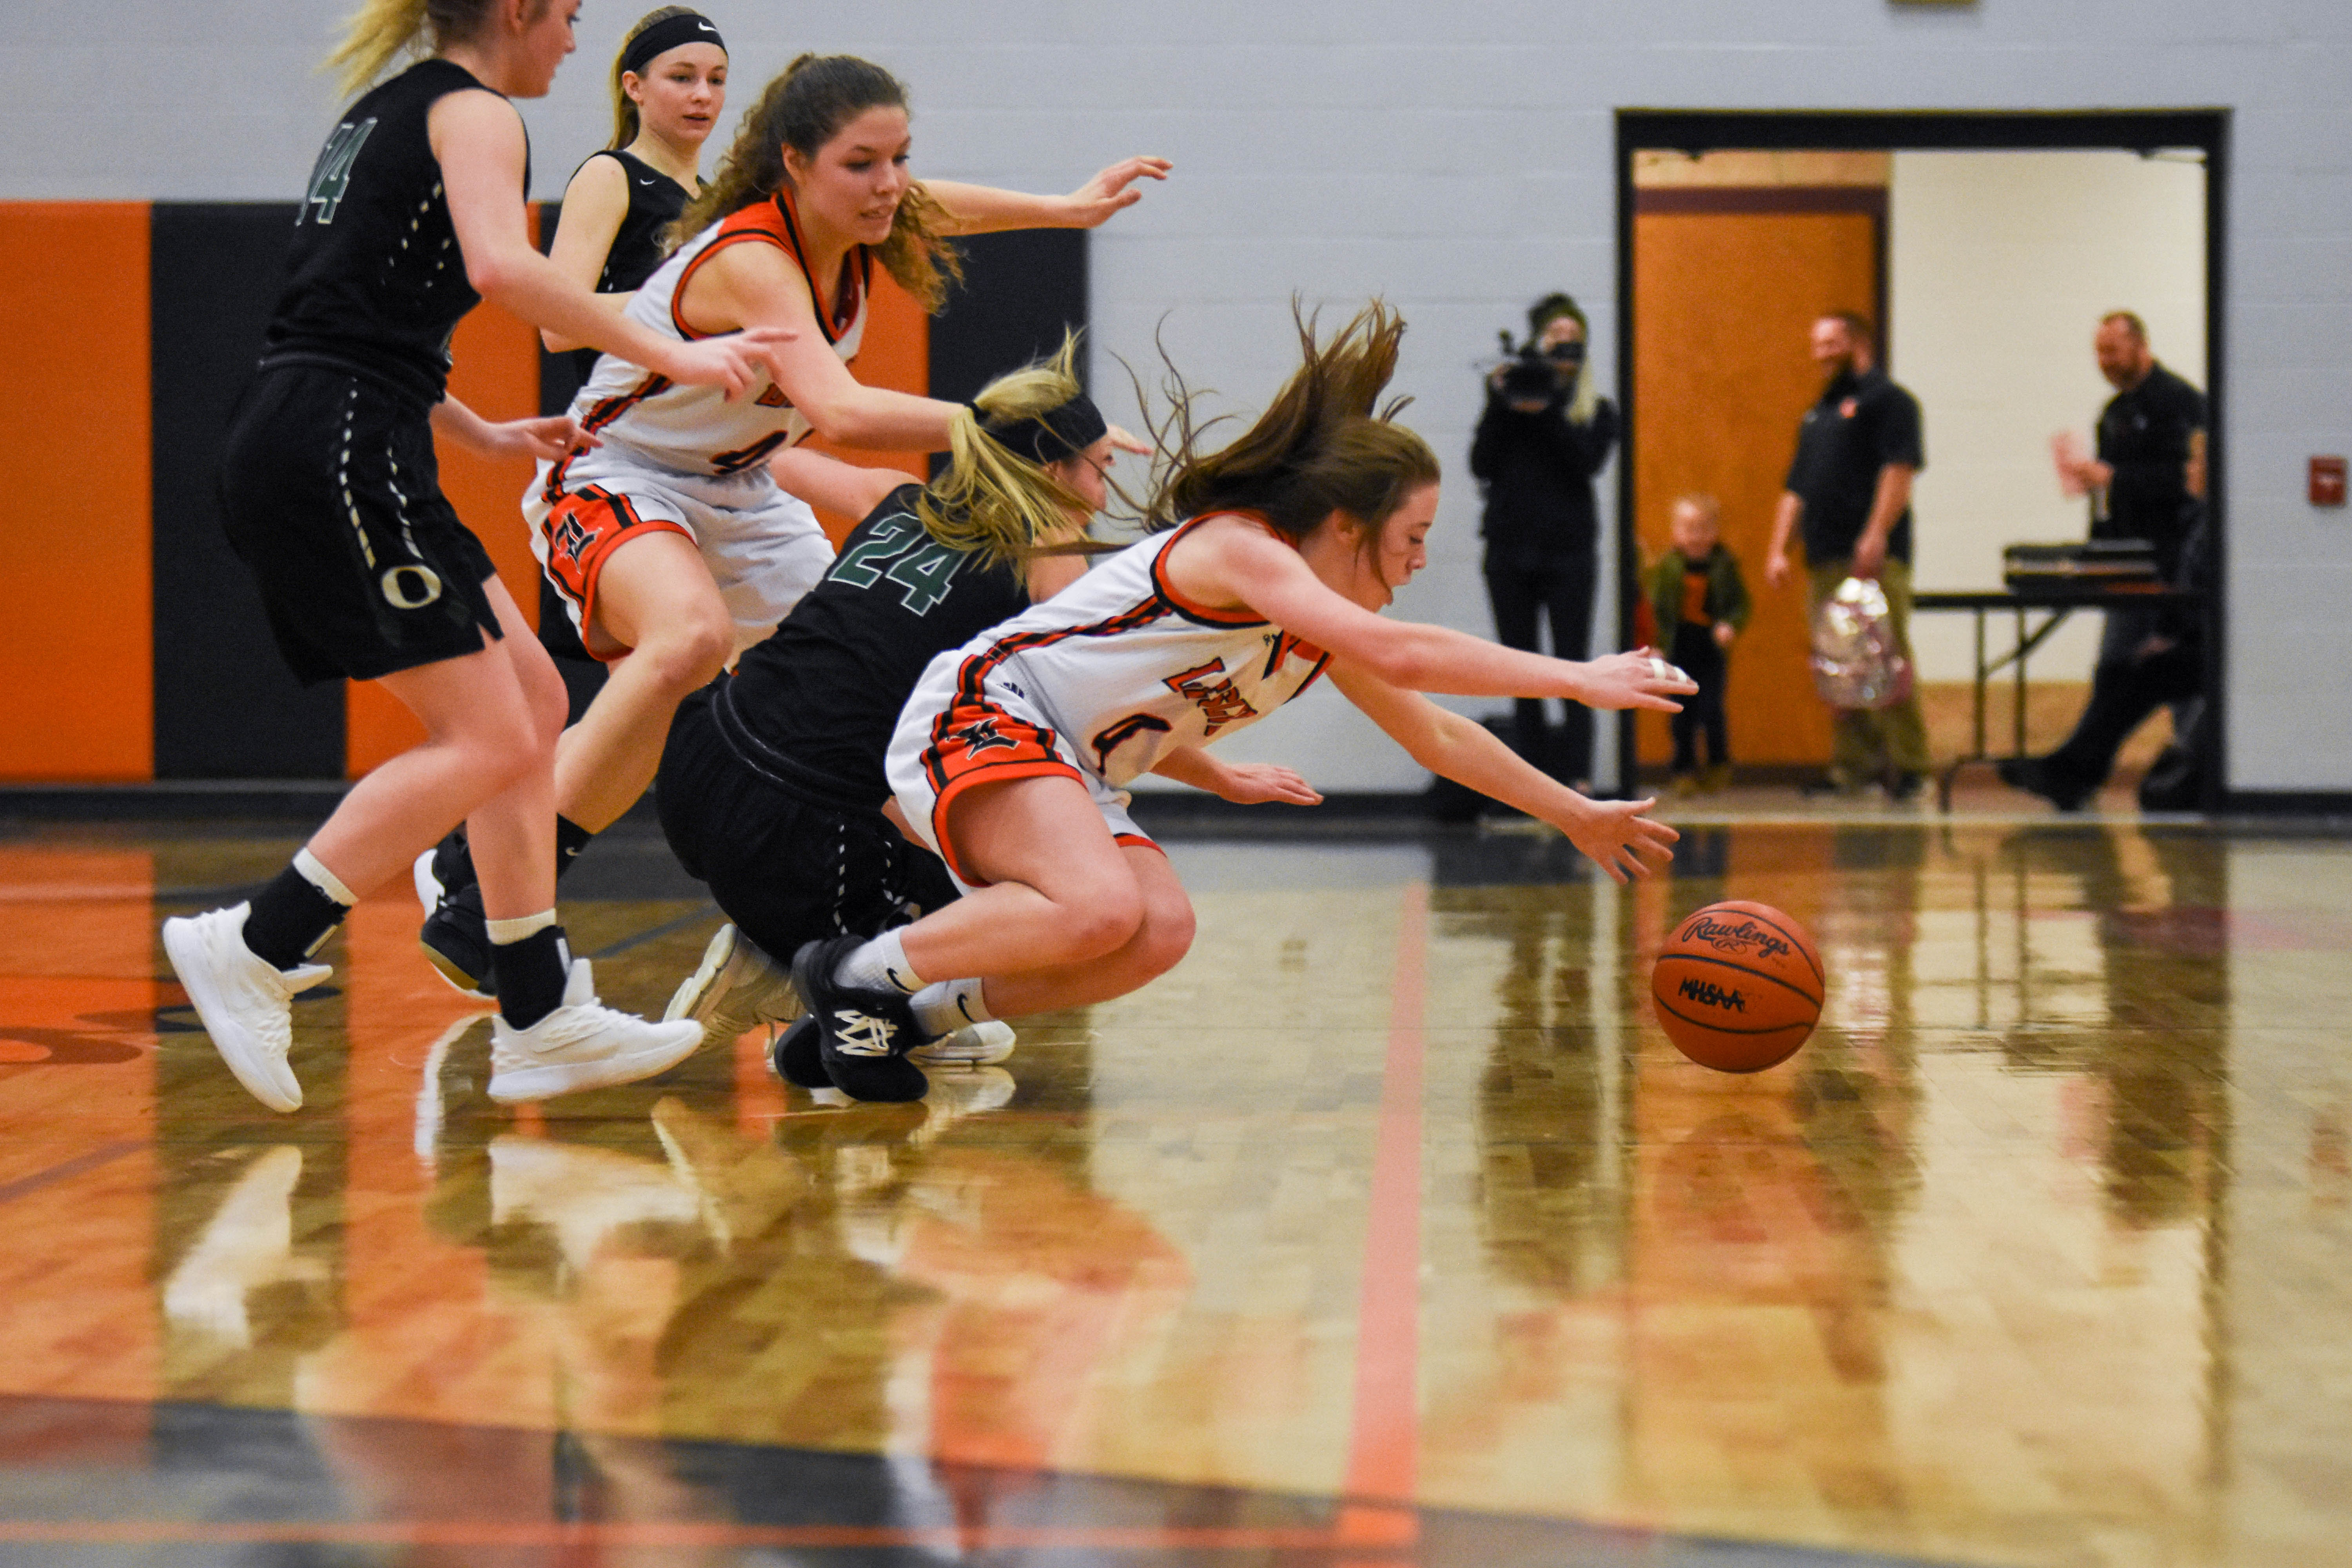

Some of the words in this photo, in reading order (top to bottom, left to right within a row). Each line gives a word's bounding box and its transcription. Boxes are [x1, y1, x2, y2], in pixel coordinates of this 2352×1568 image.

[828, 512, 970, 617] 24
[1682, 917, 1789, 958] Rawlings
[1678, 976, 1746, 1012] MHSAA
